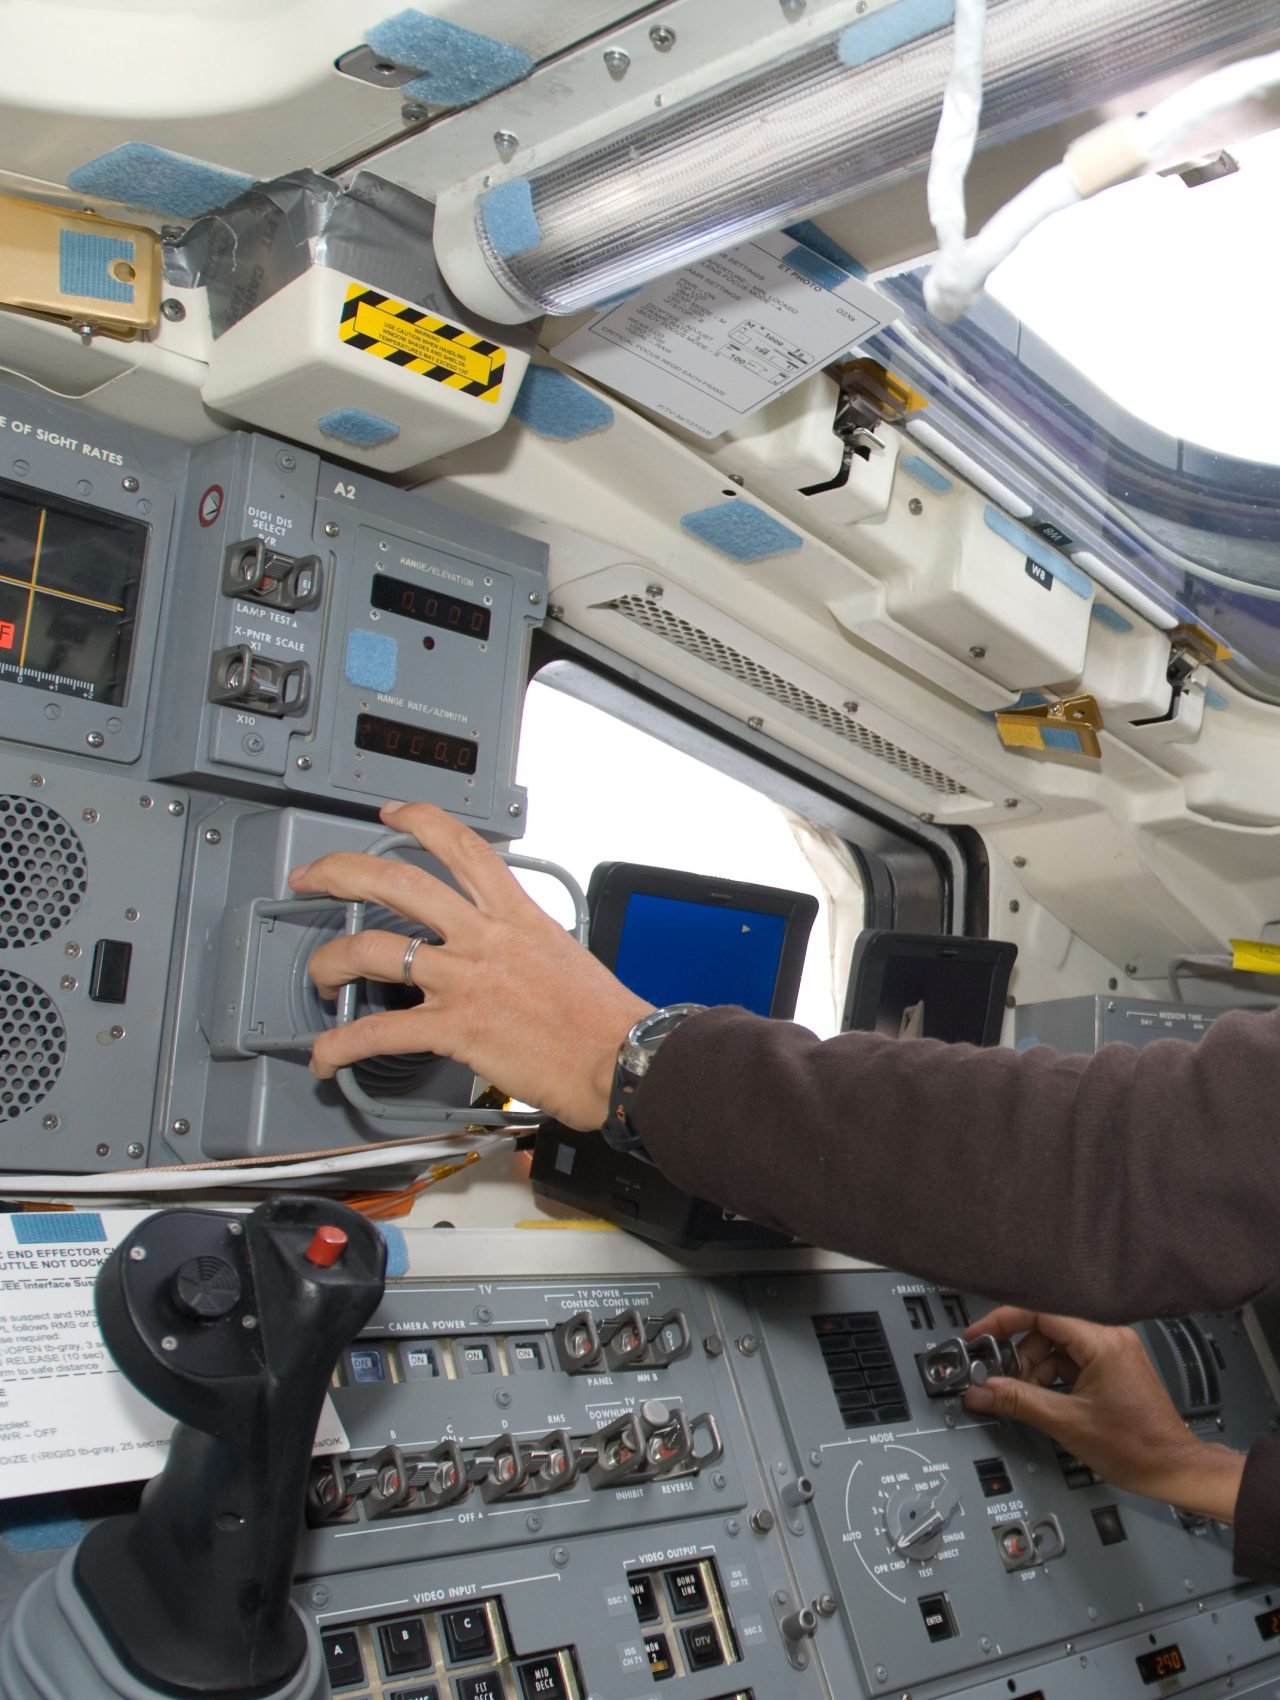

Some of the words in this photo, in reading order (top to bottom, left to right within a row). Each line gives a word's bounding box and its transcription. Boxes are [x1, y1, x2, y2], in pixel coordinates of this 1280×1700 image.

[776, 263, 791, 273] ET
[789, 271, 823, 293] PHOTO
[413, 327, 440, 343] WARNING
[383, 321, 395, 331] USE
[395, 327, 420, 342] CAUTION
[421, 338, 438, 349] WHEN
[439, 345, 466, 361] HANDLING
[378, 333, 422, 356] TEMPERATURES
[423, 352, 434, 361] MAY
[436, 358, 457, 371] EXCEED
[382, 328, 406, 342] WINDOW
[407, 338, 429, 352] SHADES
[430, 348, 442, 358] AND
[443, 354, 465, 368] SHIELDS
[12, 420, 31, 436] OF
[36, 428, 77, 451] SIGHT
[82, 444, 124, 466] RATES
[334, 482, 356, 500] A2
[248, 507, 272, 521] DIGI
[277, 516, 292, 528] DIS
[253, 520, 286, 536] SELECT
[400, 556, 474, 587] RANGE/ELEVATION
[1032, 563, 1046, 580] W8
[237, 604, 266, 618] LAMP
[270, 613, 290, 625] TEST
[234, 626, 272, 643] X-PNTR
[276, 638, 305, 652] SCALE
[377, 693, 404, 707] RANGE
[408, 701, 467, 723] RATE/AZIMUTH
[236, 715, 255, 725] X10
[1159, 1012, 1186, 1020] MISSION
[8, 1251, 33, 1259] END
[39, 1248, 100, 1258] EFFECTOR
[42, 1260, 69, 1268] NOT
[24, 1280, 71, 1289] Interface
[478, 1285, 492, 1295] TV
[897, 1285, 925, 1294] BRAKES
[561, 1300, 599, 1309] CONTROL
[603, 1299, 630, 1307] CONTR
[632, 1298, 649, 1306] UNIT
[53, 1310, 72, 1319] and
[12, 1323, 48, 1331] follows
[51, 1321, 76, 1329] RMS
[389, 1321, 428, 1332] CAMERA
[432, 1320, 466, 1330] POWER
[7, 1354, 60, 1365] RELEASE
[466, 1352, 479, 1360] ON
[518, 1350, 531, 1358] ON
[31, 1366, 53, 1374] safe
[56, 1363, 99, 1371] distance
[588, 1377, 613, 1386] PANEL
[637, 1374, 650, 1382] MN
[624, 1397, 635, 1405] TV
[502, 1420, 507, 1429] D
[547, 1414, 566, 1424] RMS
[34, 1428, 57, 1438] OFF
[390, 1430, 396, 1439] B
[446, 1425, 452, 1433] C
[870, 1433, 895, 1444] MODE
[922, 1463, 950, 1473] MANUAL
[881, 1475, 895, 1484] ORB
[896, 1473, 909, 1481] UNL
[662, 1482, 694, 1493] REVERSE
[915, 1482, 928, 1491] END
[616, 1489, 643, 1500] INHIBIT
[987, 1504, 1007, 1515] AUTO
[1009, 1500, 1023, 1511] SEQ
[458, 1513, 475, 1523] OFF
[996, 1511, 1021, 1522] PROCEED
[842, 1531, 861, 1542] AUTO
[875, 1528, 880, 1536] 2
[943, 1532, 965, 1543] SINGLE
[639, 1552, 664, 1564] VIDEO
[667, 1545, 697, 1558] OUTPUT
[938, 1549, 959, 1560] DIRECT
[874, 1565, 889, 1574] OPR
[890, 1561, 905, 1571] CMD
[919, 1568, 933, 1578] TEST
[677, 1574, 695, 1586] DOWN
[1021, 1572, 1035, 1581] STOP
[413, 1590, 444, 1604] VIDEO
[448, 1584, 477, 1598] INPUT
[681, 1586, 696, 1597] LINK
[464, 1618, 471, 1628] C
[926, 1614, 943, 1626] ENTER
[402, 1630, 409, 1640] B
[695, 1635, 711, 1646] DTV
[334, 1645, 343, 1655] A
[623, 1658, 633, 1666] CH
[652, 1653, 657, 1662] 2
[535, 1668, 549, 1680] MID
[475, 1682, 487, 1693] FLT
[535, 1678, 555, 1691] DECK
